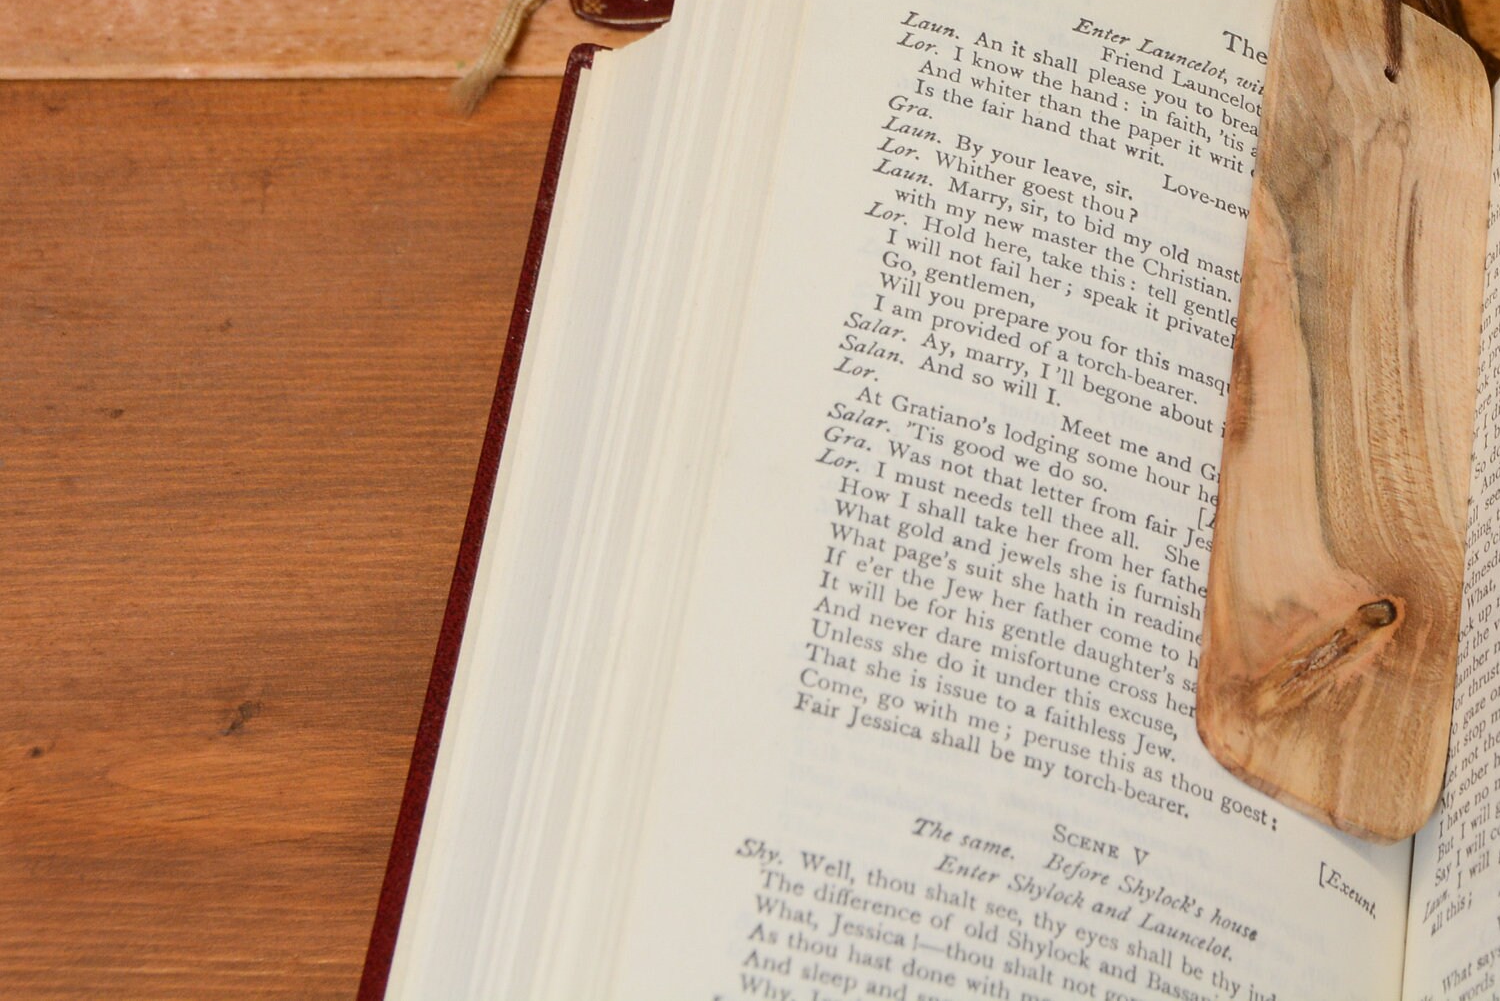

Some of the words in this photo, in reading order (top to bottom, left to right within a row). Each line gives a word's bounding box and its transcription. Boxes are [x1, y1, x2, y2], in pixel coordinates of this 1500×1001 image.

[1222, 30, 1268, 65] The
[881, 115, 941, 144] Laun.
[955, 133, 984, 159] By
[990, 148, 1036, 170] your
[1043, 158, 1096, 191] leave,
[1105, 180, 1133, 201] sir.
[914, 78, 935, 98] Is
[943, 88, 974, 109] the
[981, 98, 1015, 120] fair
[1021, 108, 1071, 137] hand
[1079, 127, 1117, 151] that
[1124, 144, 1164, 167] writ.
[876, 136, 920, 161] Lor.
[936, 150, 1016, 187] Whither
[1022, 181, 1074, 204] goest
[1082, 194, 1138, 224] thou?
[874, 293, 885, 312] I
[891, 305, 922, 322] am
[931, 315, 1021, 348] provided
[1029, 340, 1052, 356] of
[1057, 350, 1068, 362] a
[1077, 353, 1198, 405] torch-bearer.
[812, 617, 883, 653] Unless
[893, 641, 928, 664] she
[936, 651, 964, 673] do
[972, 660, 987, 680] it
[996, 670, 1057, 698] under
[1064, 687, 1101, 712] this
[1108, 704, 1178, 742] excuse,
[912, 817, 953, 842] The
[960, 834, 1015, 860] same.
[1044, 852, 1110, 886] Before
[1209, 907, 1258, 942] house
[1052, 823, 1120, 860] SCENE
[1133, 846, 1150, 867] V
[934, 854, 1000, 883] Enter
[1007, 874, 1085, 909] Shylock
[1091, 901, 1133, 922] and
[1137, 912, 1233, 962] Launcelot.
